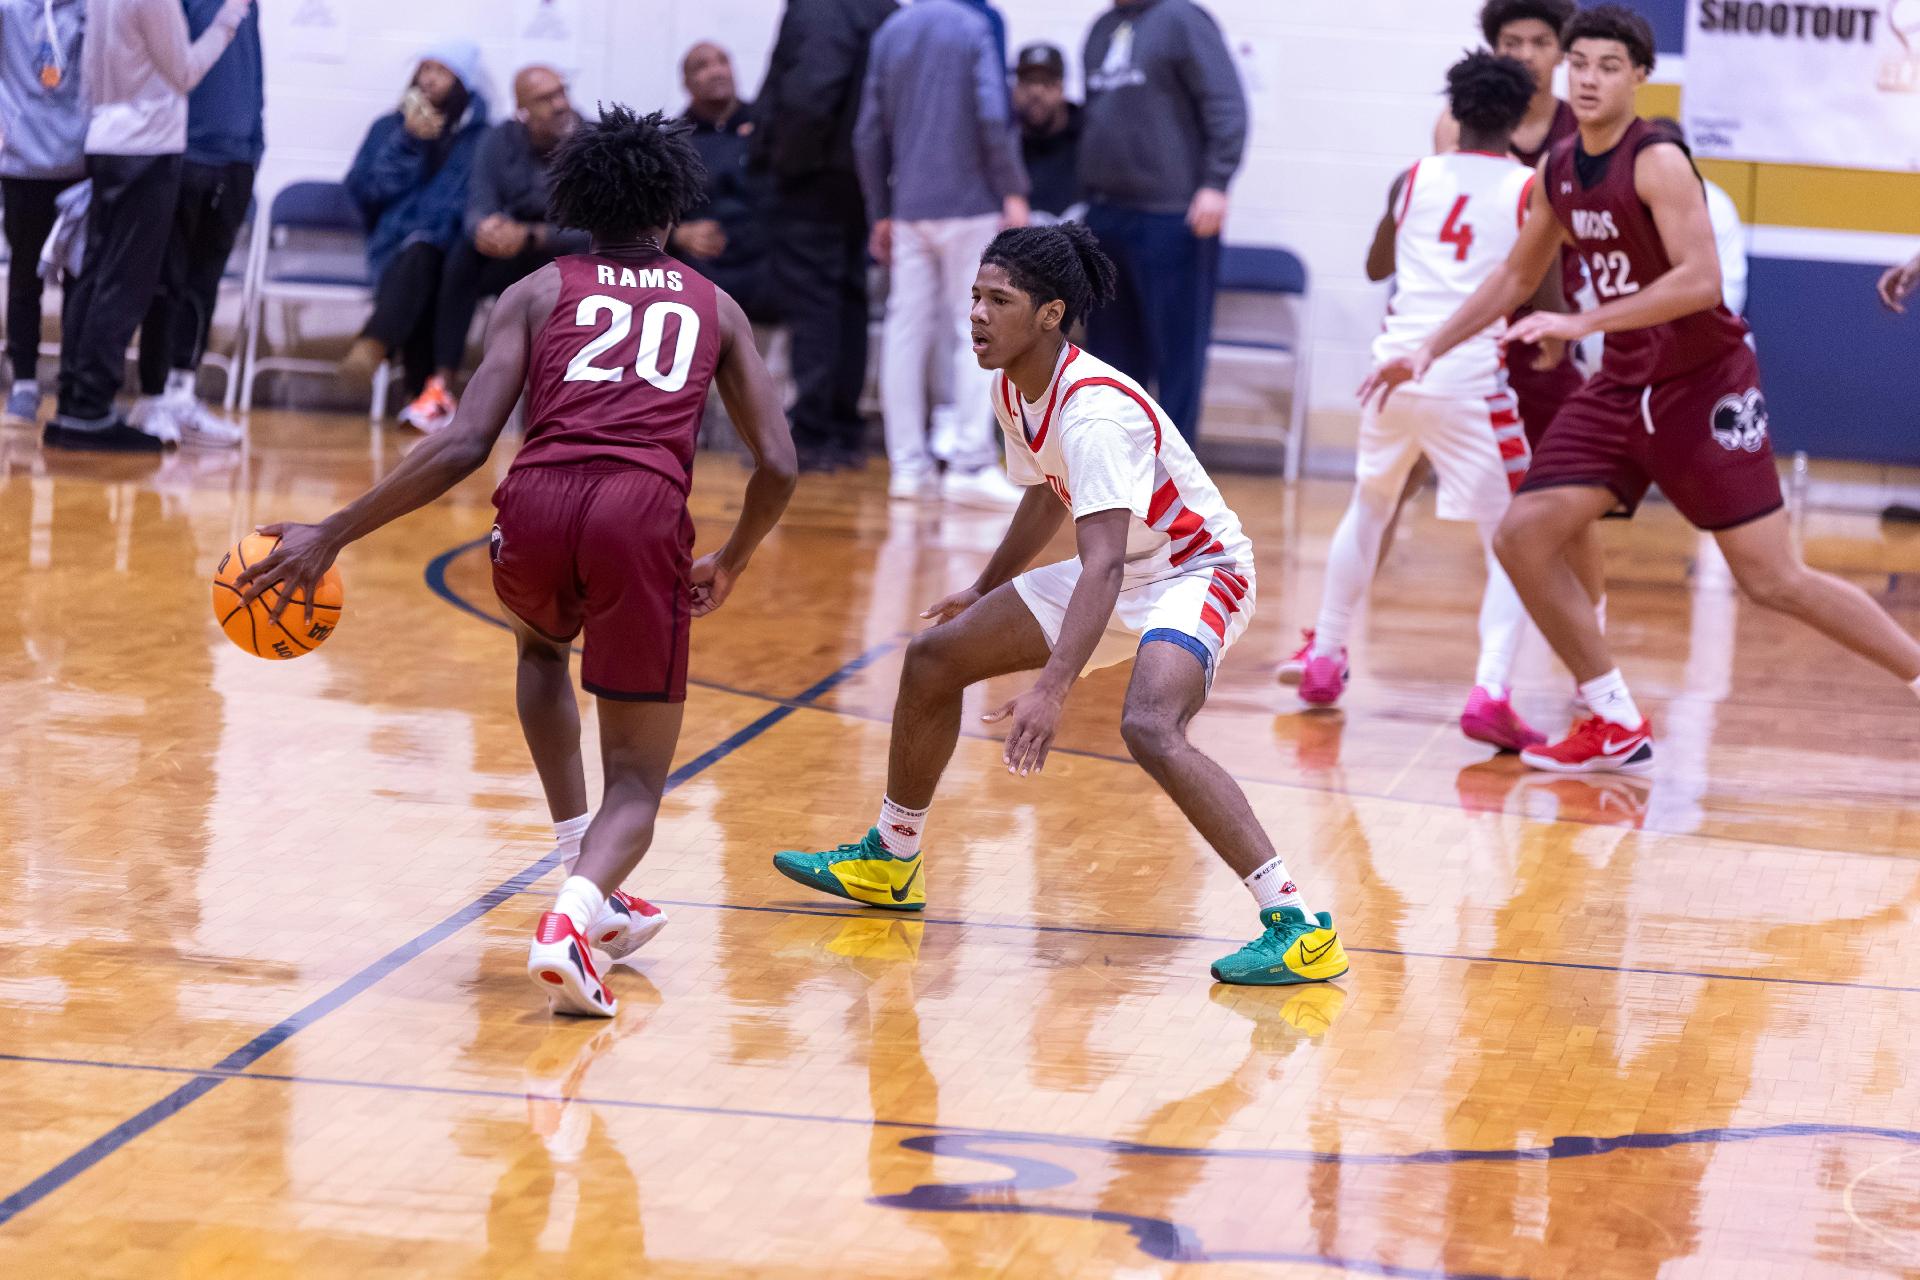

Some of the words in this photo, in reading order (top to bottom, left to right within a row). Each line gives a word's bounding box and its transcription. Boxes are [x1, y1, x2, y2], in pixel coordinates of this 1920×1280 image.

[1700, 0, 1878, 43] SHOOTOUT
[1440, 194, 1473, 261] 4
[597, 264, 684, 292] RAMS
[1592, 250, 1640, 298] 22
[563, 294, 701, 393] 20
